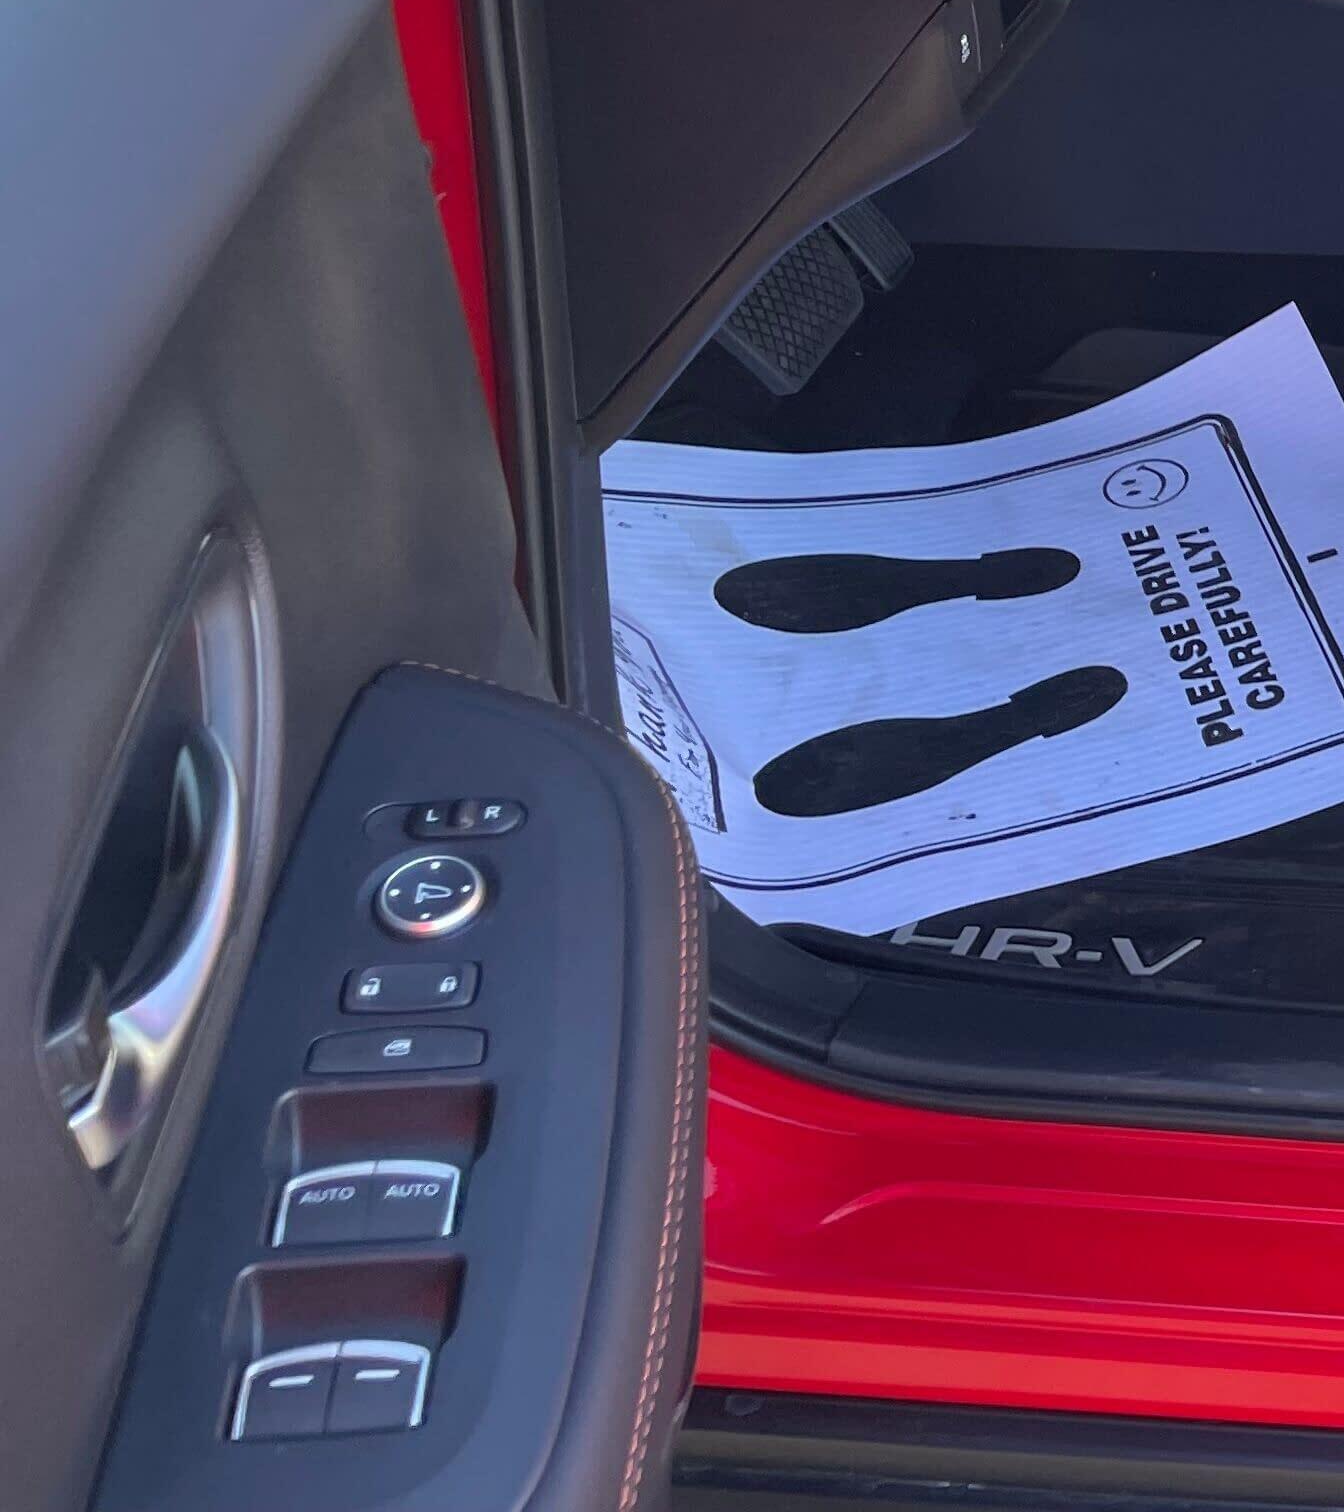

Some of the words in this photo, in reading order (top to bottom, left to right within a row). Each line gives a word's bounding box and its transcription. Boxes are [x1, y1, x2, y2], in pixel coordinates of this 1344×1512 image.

[1121, 525, 1190, 615] DRIVE
[1176, 525, 1285, 710] CAREFULLY!
[1160, 618, 1244, 747] PLEASE
[425, 808, 440, 823] L
[484, 805, 502, 820] R
[889, 920, 1206, 978] HR-V
[299, 1185, 357, 1206] AUTO
[382, 1182, 441, 1200] AUTO
